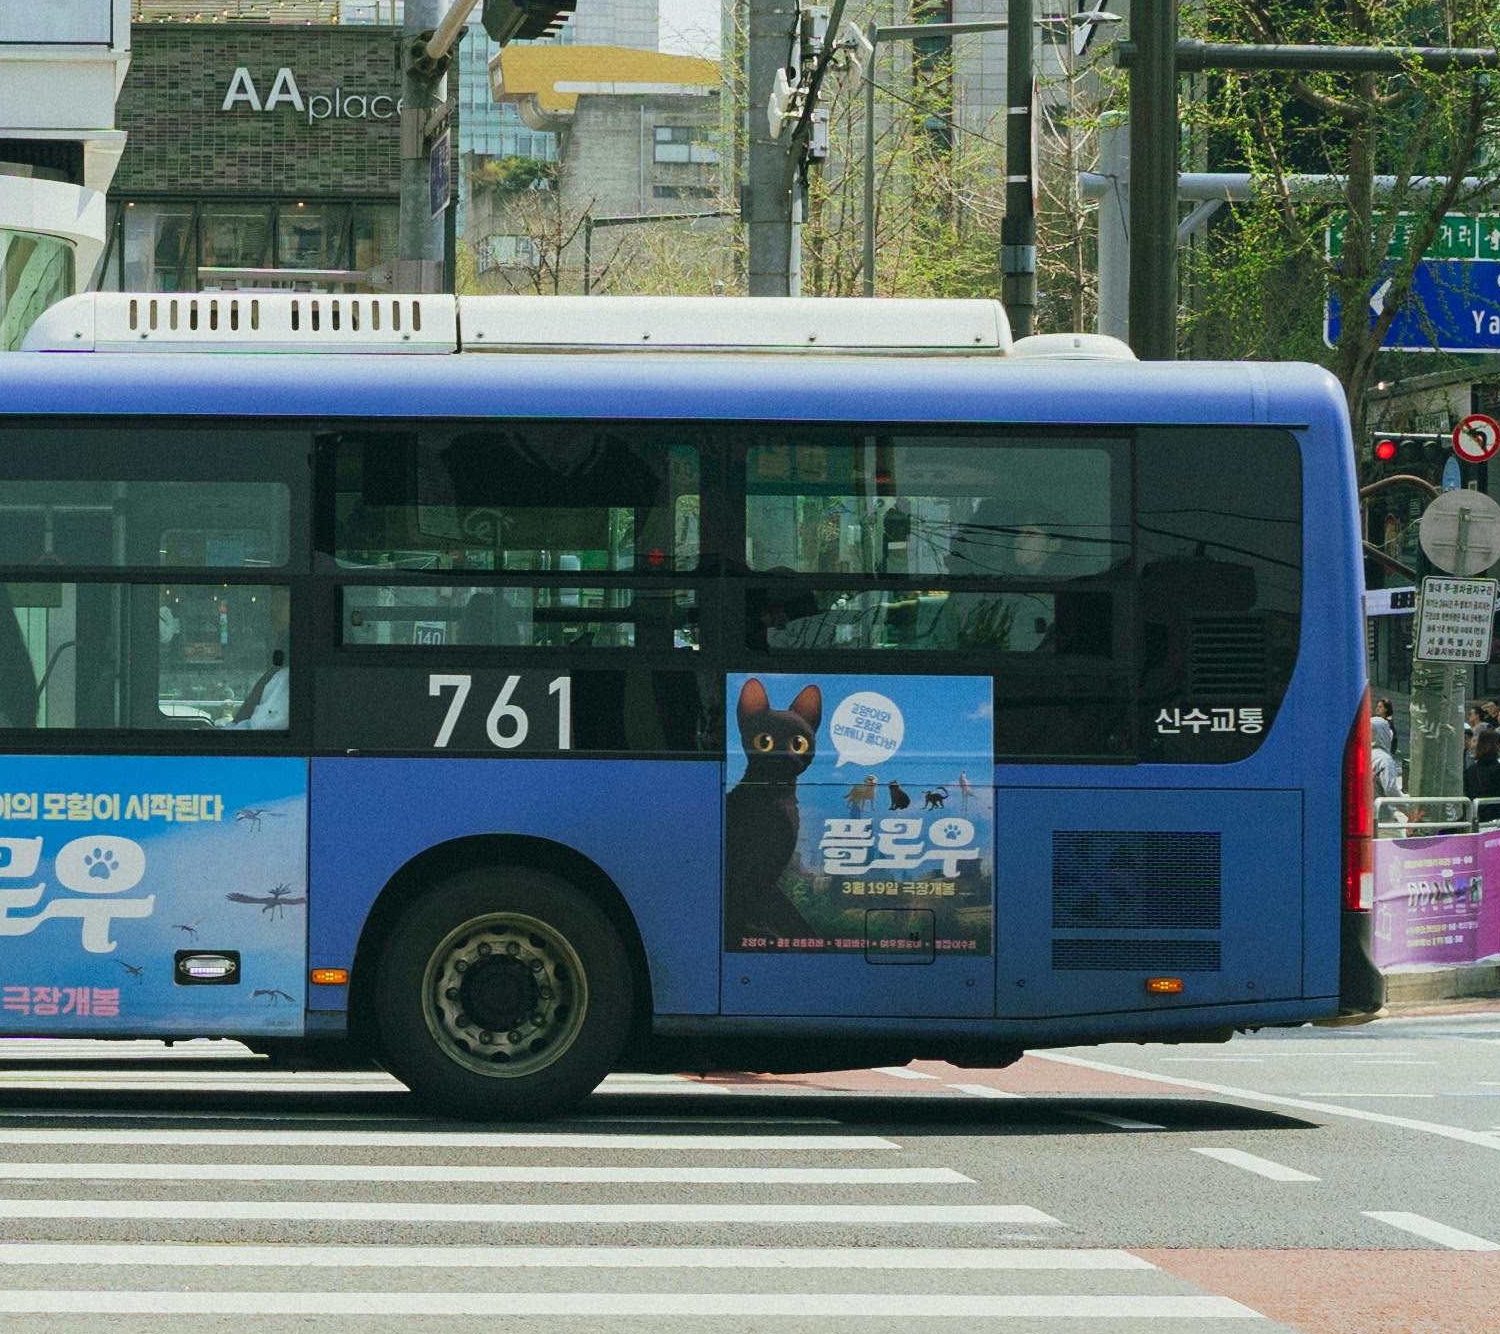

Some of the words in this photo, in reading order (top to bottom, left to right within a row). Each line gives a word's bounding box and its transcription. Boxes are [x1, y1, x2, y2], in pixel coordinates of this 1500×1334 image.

[416, 631, 442, 645] 140
[428, 674, 572, 750] 761
[851, 702, 892, 724] 고양이와
[852, 716, 884, 734] 모험은
[1154, 708, 1264, 734] 신수교통
[43, 793, 120, 821] 모험이
[124, 793, 224, 822] 시작된다
[819, 817, 980, 878] 플로우
[842, 882, 865, 895] 3월
[867, 882, 899, 896] 19일
[902, 882, 956, 896] 극장개봉
[2, 986, 121, 1017] 극장개봉
